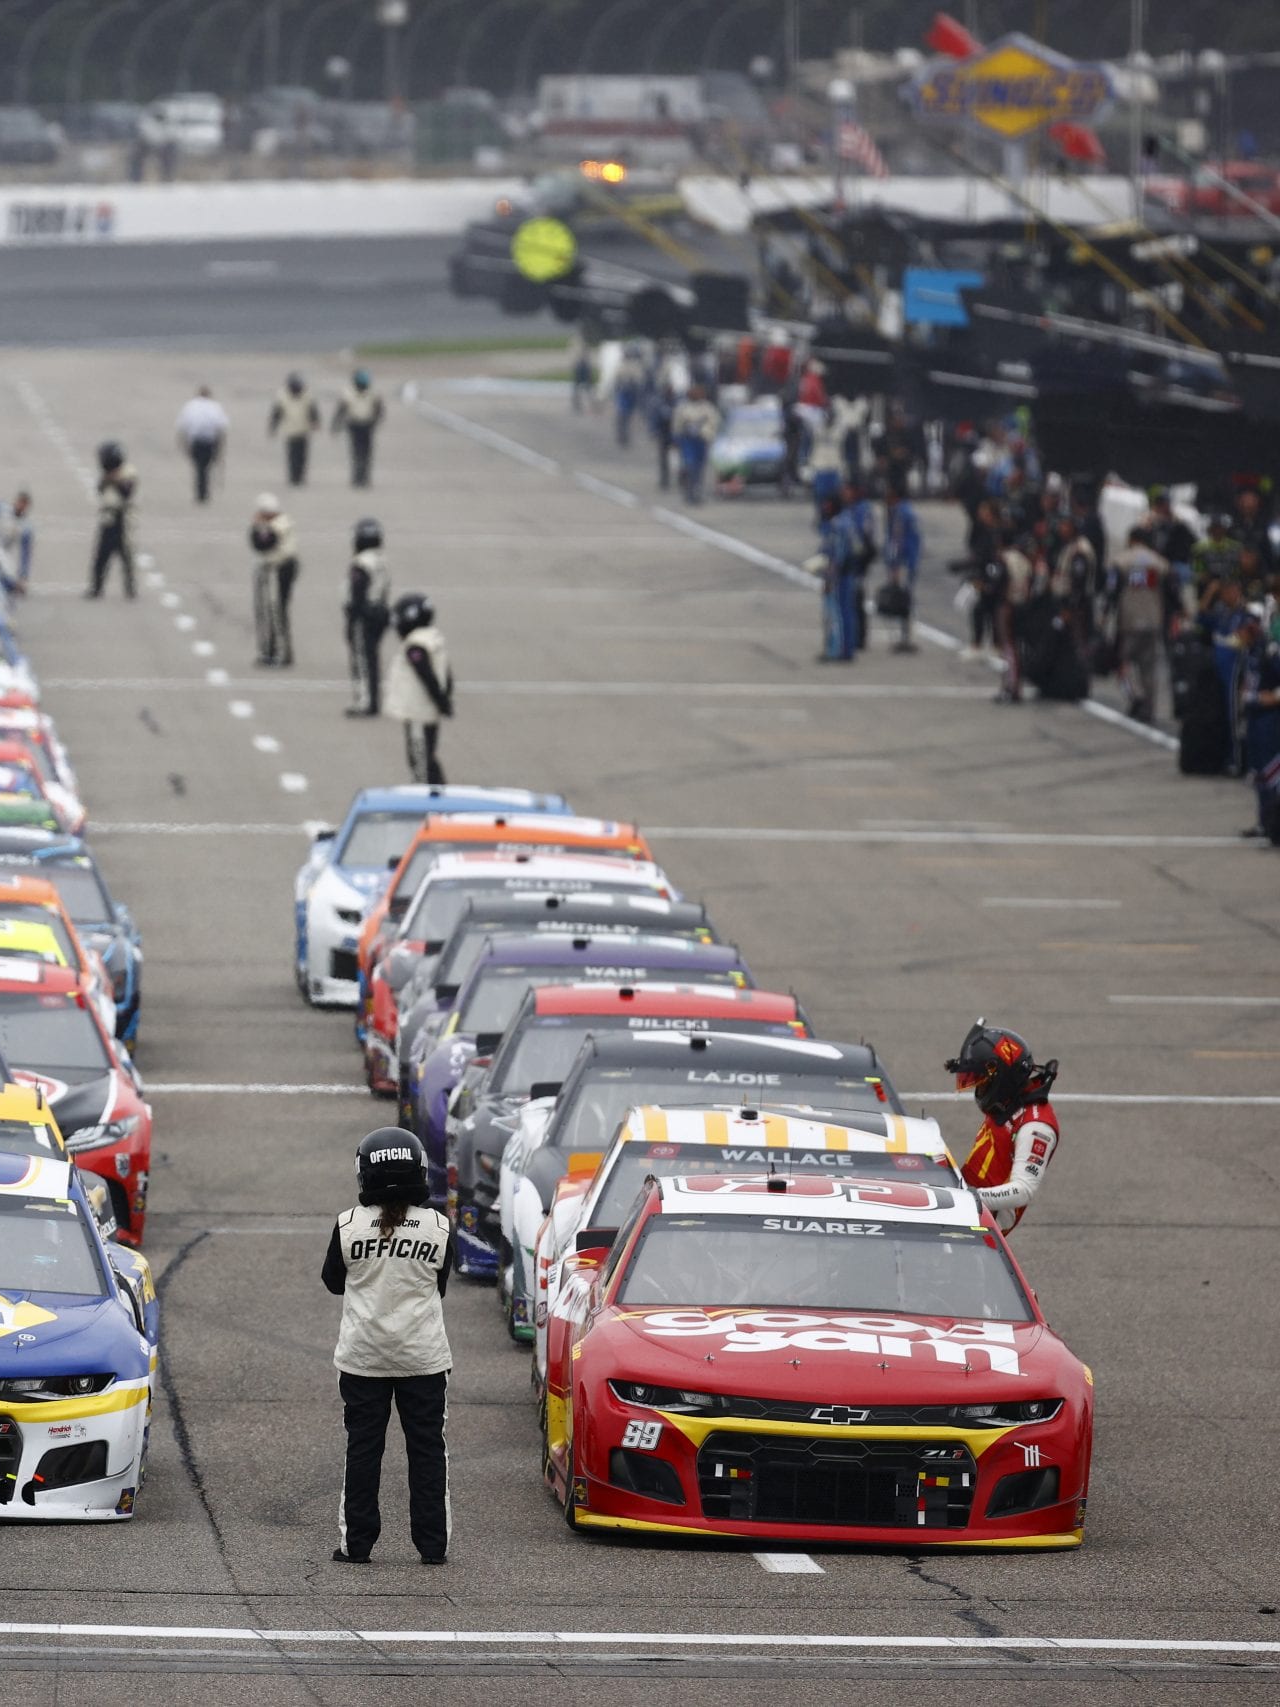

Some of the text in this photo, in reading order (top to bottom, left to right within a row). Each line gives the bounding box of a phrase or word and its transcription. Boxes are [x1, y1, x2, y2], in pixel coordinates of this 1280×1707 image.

[537, 921, 639, 935] SMITHLEY
[584, 966, 647, 979] WARE
[628, 1018, 710, 1031] BILICKI
[687, 1071, 782, 1086] LAJOIE
[370, 1147, 413, 1163] OFFICIAL
[721, 1149, 854, 1167] WALLACE
[762, 1218, 885, 1236] SUAREZ
[351, 1238, 439, 1263] OFFICIAL
[643, 1312, 1016, 1344] good
[720, 1330, 1021, 1376] sam
[621, 1419, 664, 1450] 99
[920, 1449, 963, 1460] ZL1
